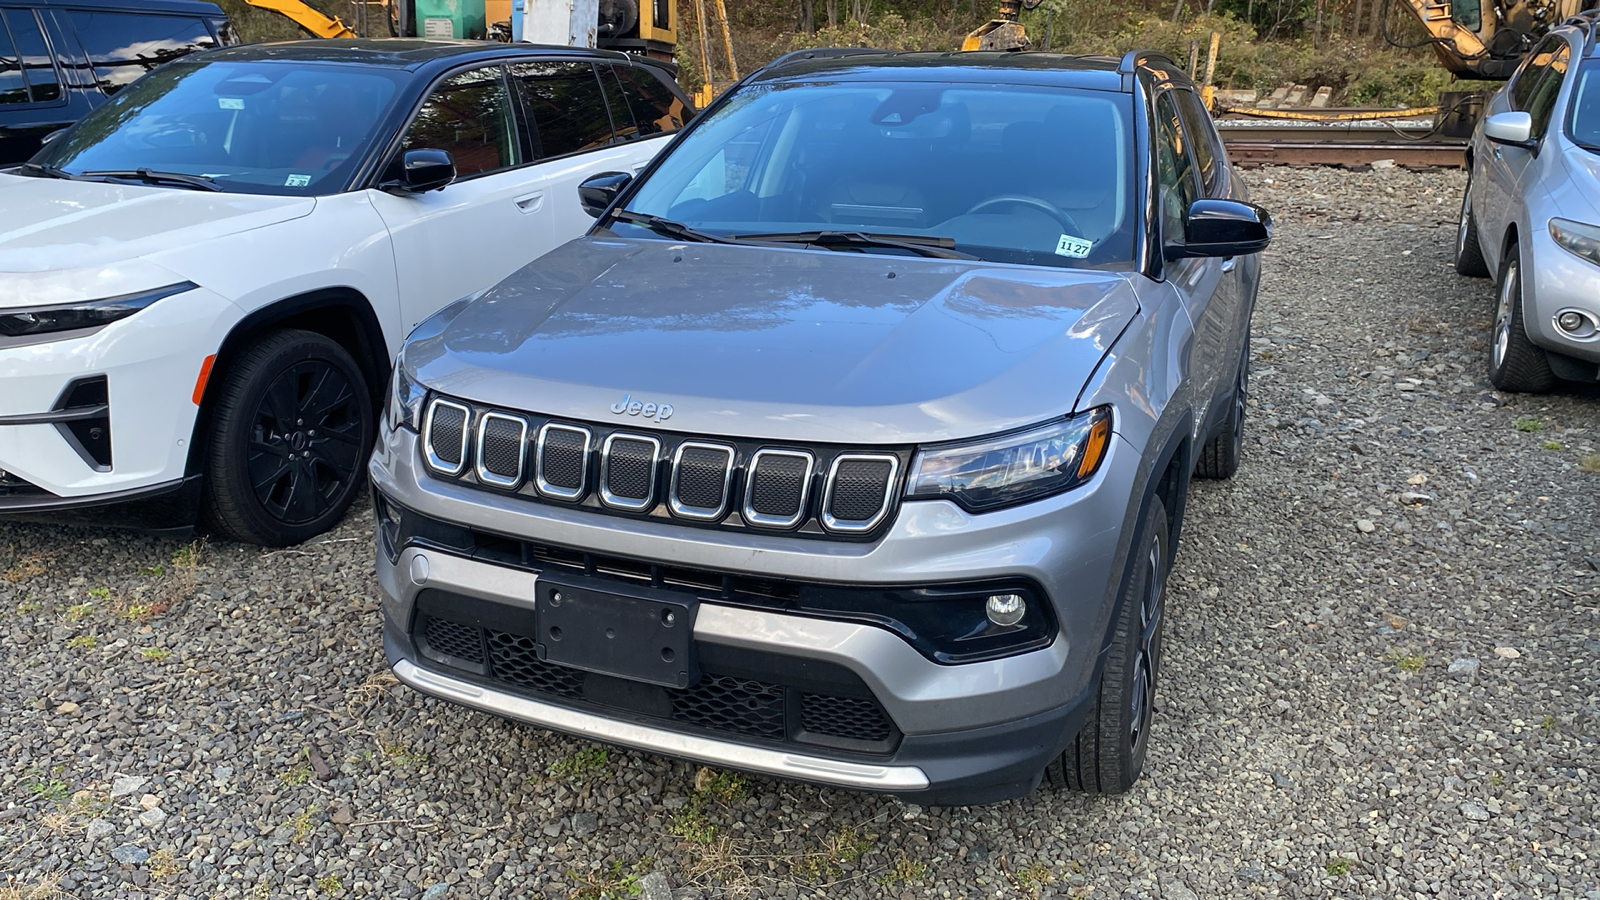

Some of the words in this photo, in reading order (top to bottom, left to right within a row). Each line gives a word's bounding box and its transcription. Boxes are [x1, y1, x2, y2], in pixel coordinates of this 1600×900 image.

[1060, 241, 1072, 251] 11
[1073, 244, 1089, 255] 27
[610, 394, 674, 424] Jeep
